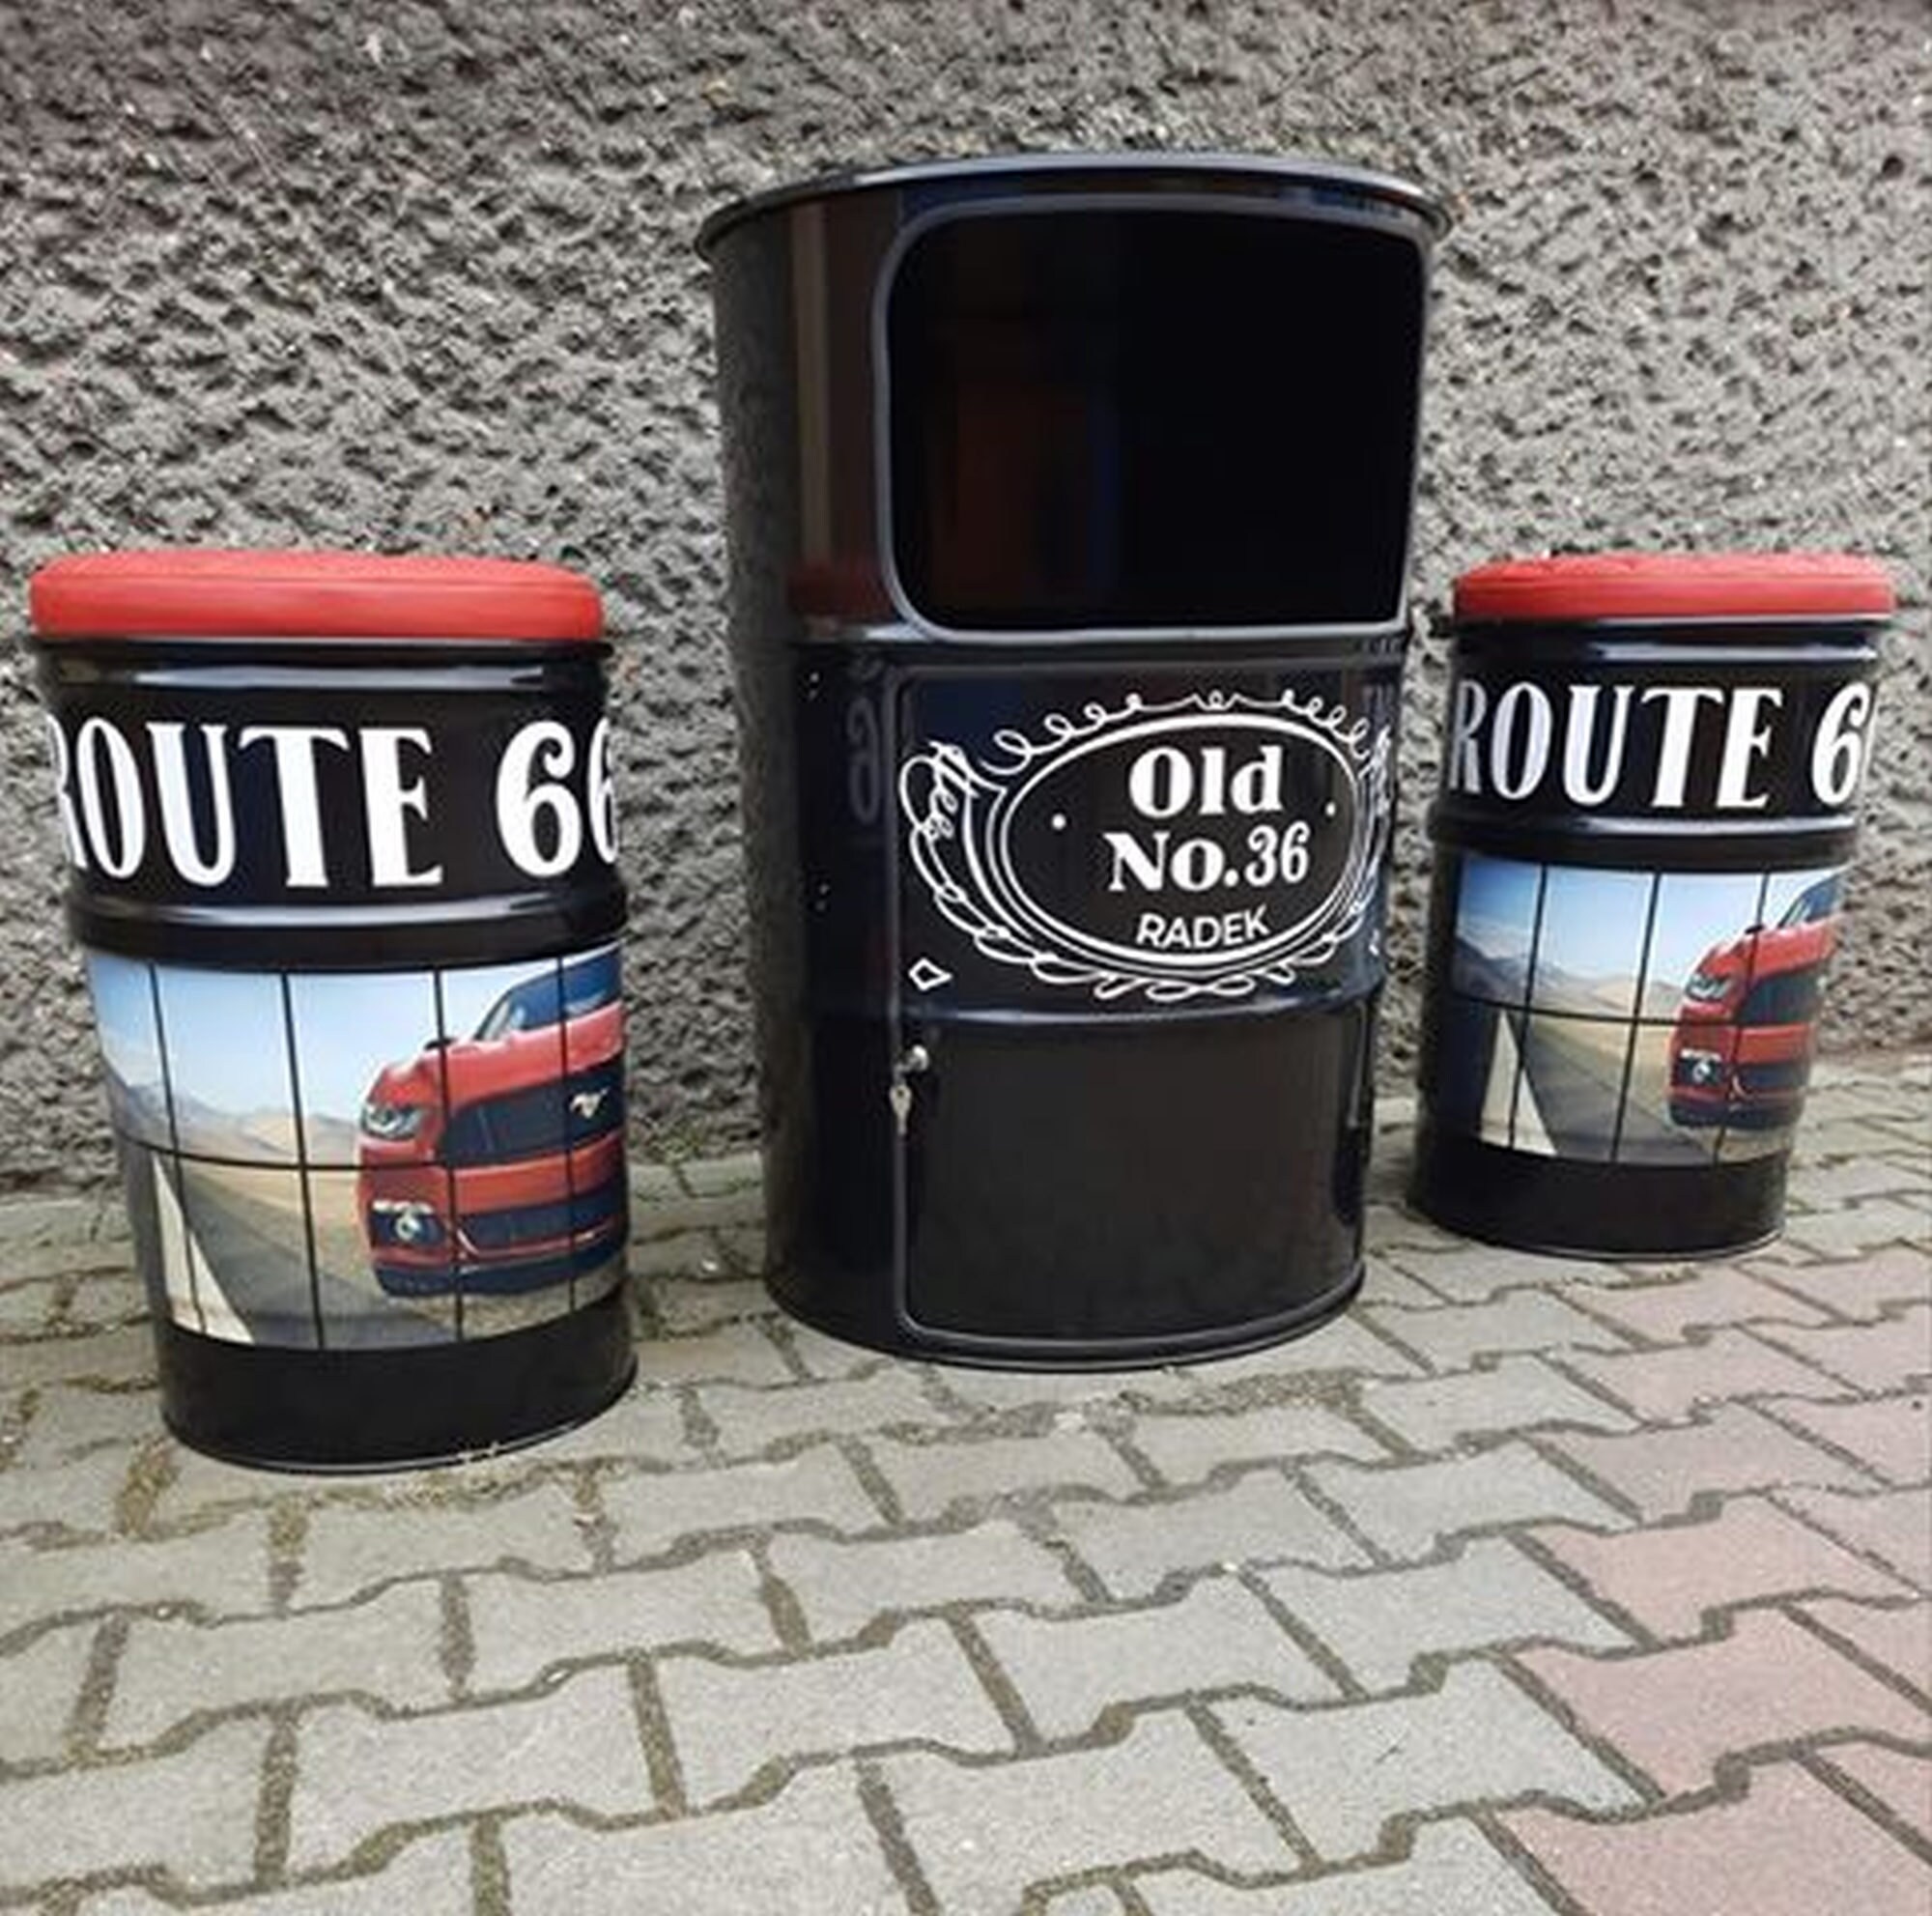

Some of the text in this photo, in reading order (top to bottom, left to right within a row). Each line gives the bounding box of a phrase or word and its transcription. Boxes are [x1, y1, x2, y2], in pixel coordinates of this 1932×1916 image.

[1451, 680, 1876, 808] ROUTE 6
[1130, 746, 1283, 818] Old
[1104, 821, 1311, 891] No.36
[1136, 905, 1270, 949] RADEK
